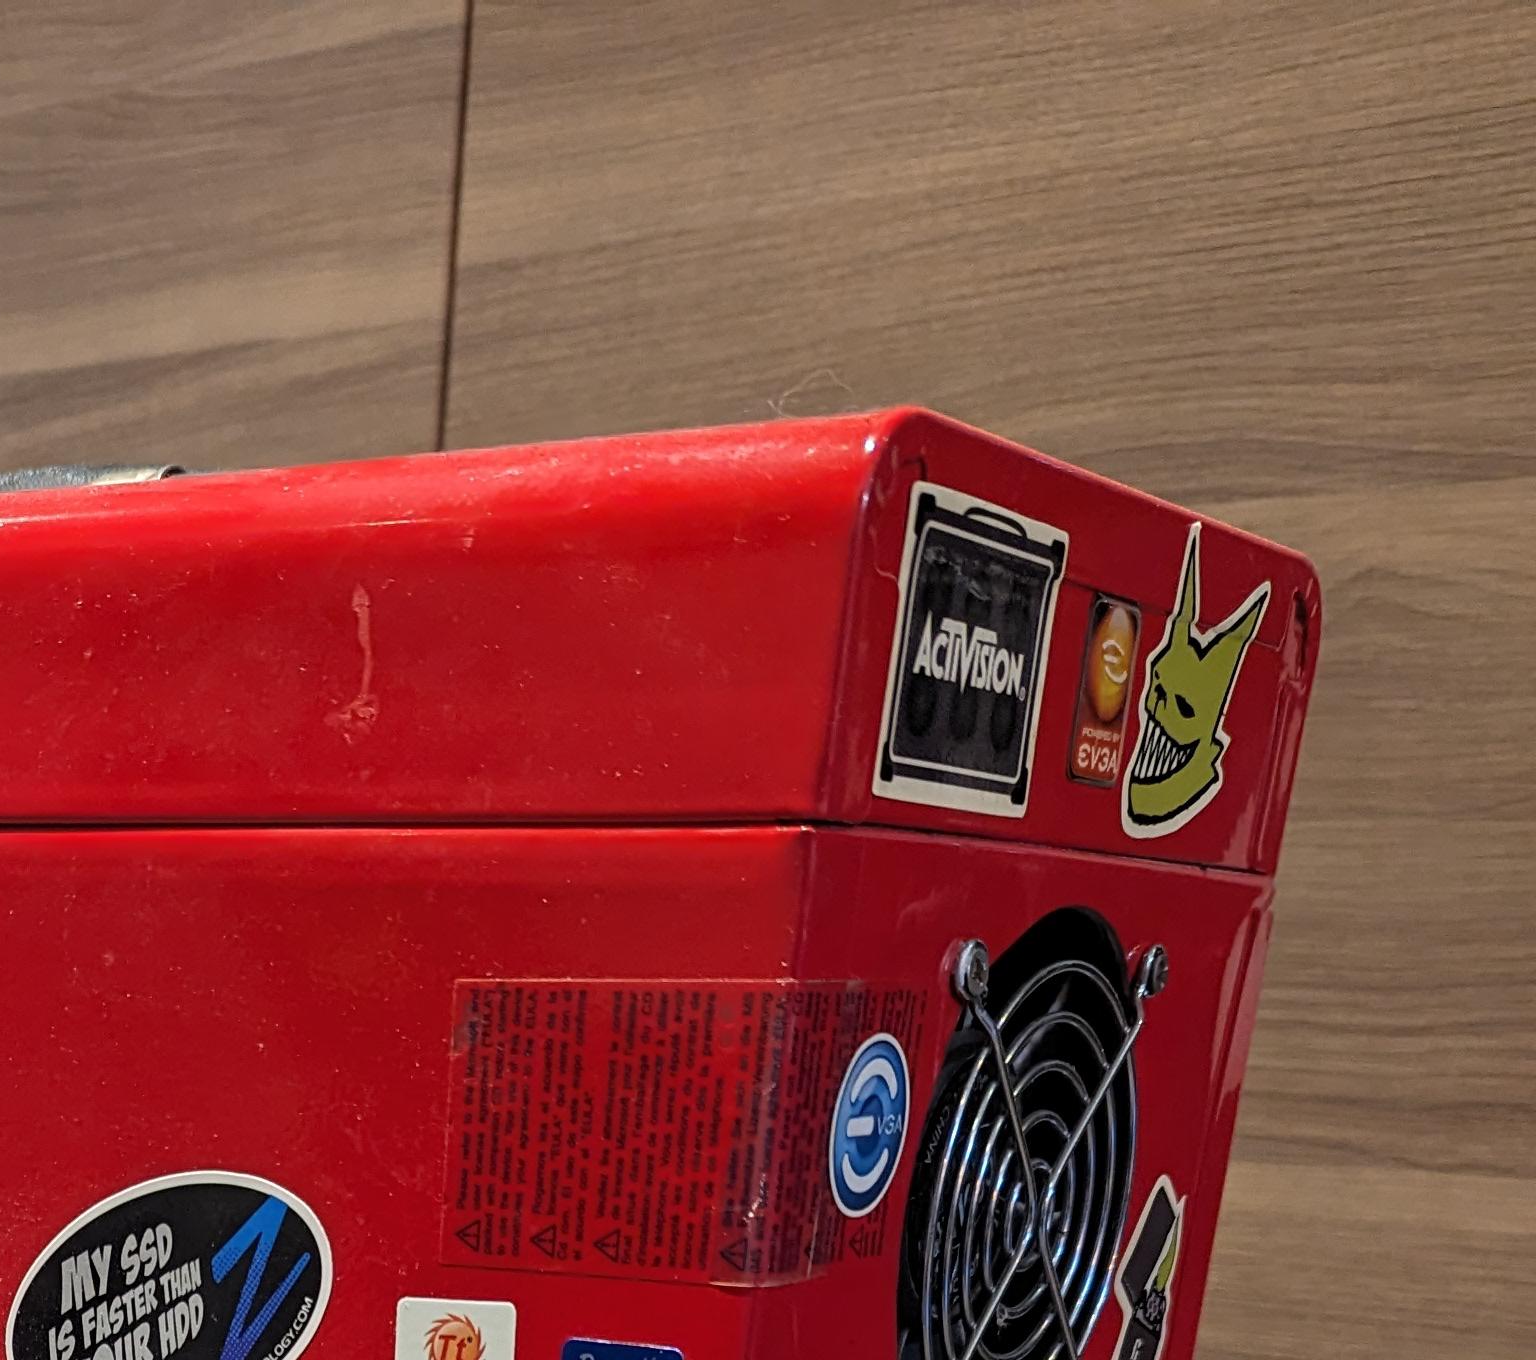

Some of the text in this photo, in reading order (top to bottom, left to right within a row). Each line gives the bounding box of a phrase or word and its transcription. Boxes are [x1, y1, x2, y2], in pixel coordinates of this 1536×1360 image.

[60, 1223, 173, 1316] MY SSD
[82, 1280, 158, 1350] FASTER
[160, 1258, 202, 1302] THAN
[158, 1294, 204, 1360] HDD
